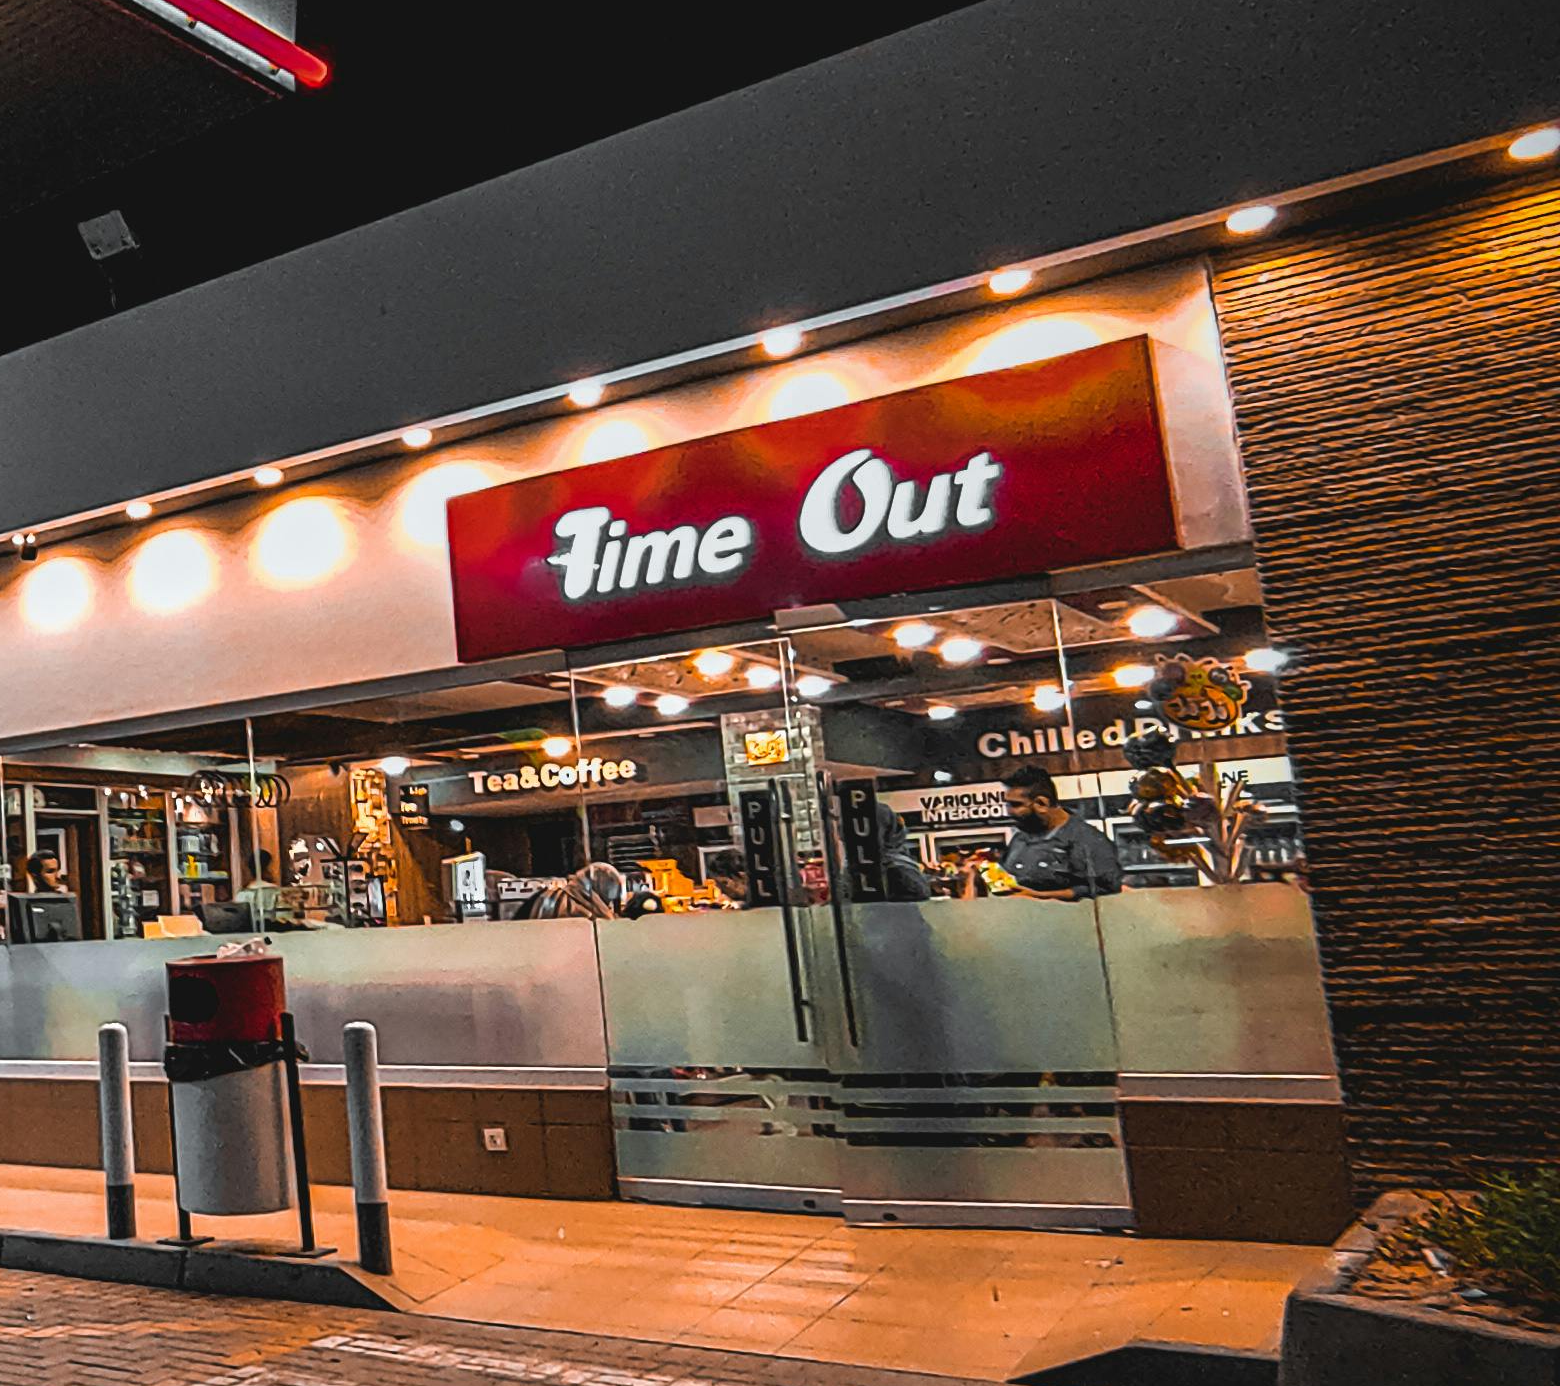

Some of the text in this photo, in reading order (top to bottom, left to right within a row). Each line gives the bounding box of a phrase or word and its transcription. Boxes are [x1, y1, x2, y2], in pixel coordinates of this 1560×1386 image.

[545, 447, 1003, 600] Time Out
[467, 757, 637, 794] Tea&Coffee
[977, 716, 1129, 758] Chilled
[1133, 708, 1285, 744] Dks
[747, 800, 773, 898] PULL
[850, 789, 878, 892] PULL
